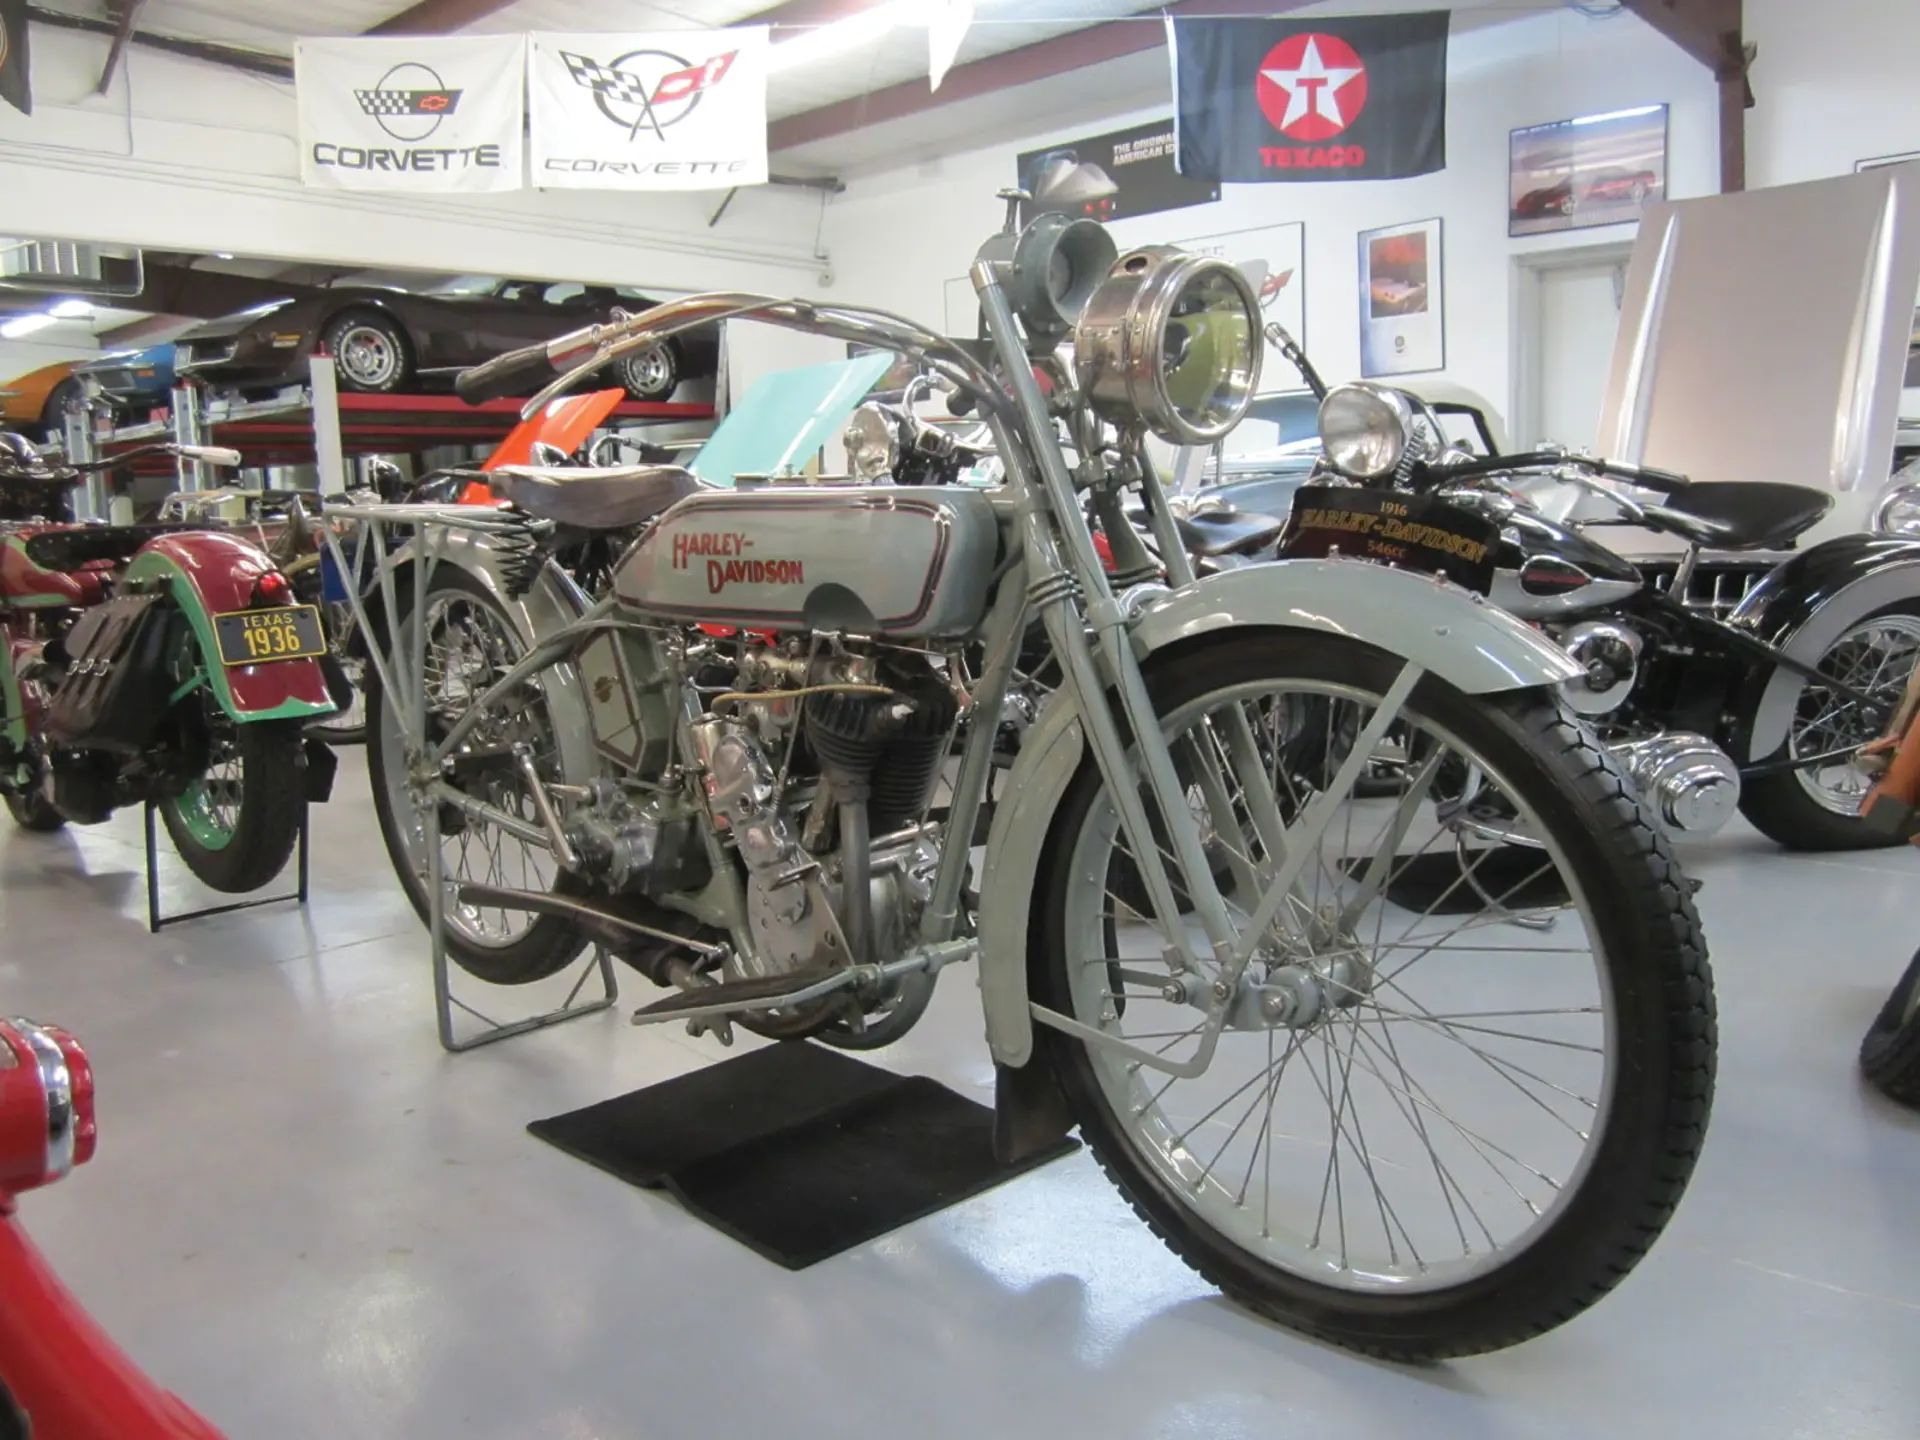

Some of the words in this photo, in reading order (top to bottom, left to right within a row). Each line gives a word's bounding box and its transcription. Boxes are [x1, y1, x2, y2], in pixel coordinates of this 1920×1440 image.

[313, 143, 500, 171] CORVETTE
[1113, 142, 1131, 154] THE
[1113, 146, 1163, 166] AMERICAN
[1259, 144, 1366, 168] TEXACO
[545, 158, 747, 174] CORVETTE
[1380, 501, 1408, 517] 1916
[1300, 508, 1487, 564] HARLEY-DAVIDSON
[672, 532, 754, 569] HARLEY-
[707, 559, 804, 594] DAVIDSON
[242, 613, 293, 628] TEXAS
[244, 625, 301, 656] 1936
